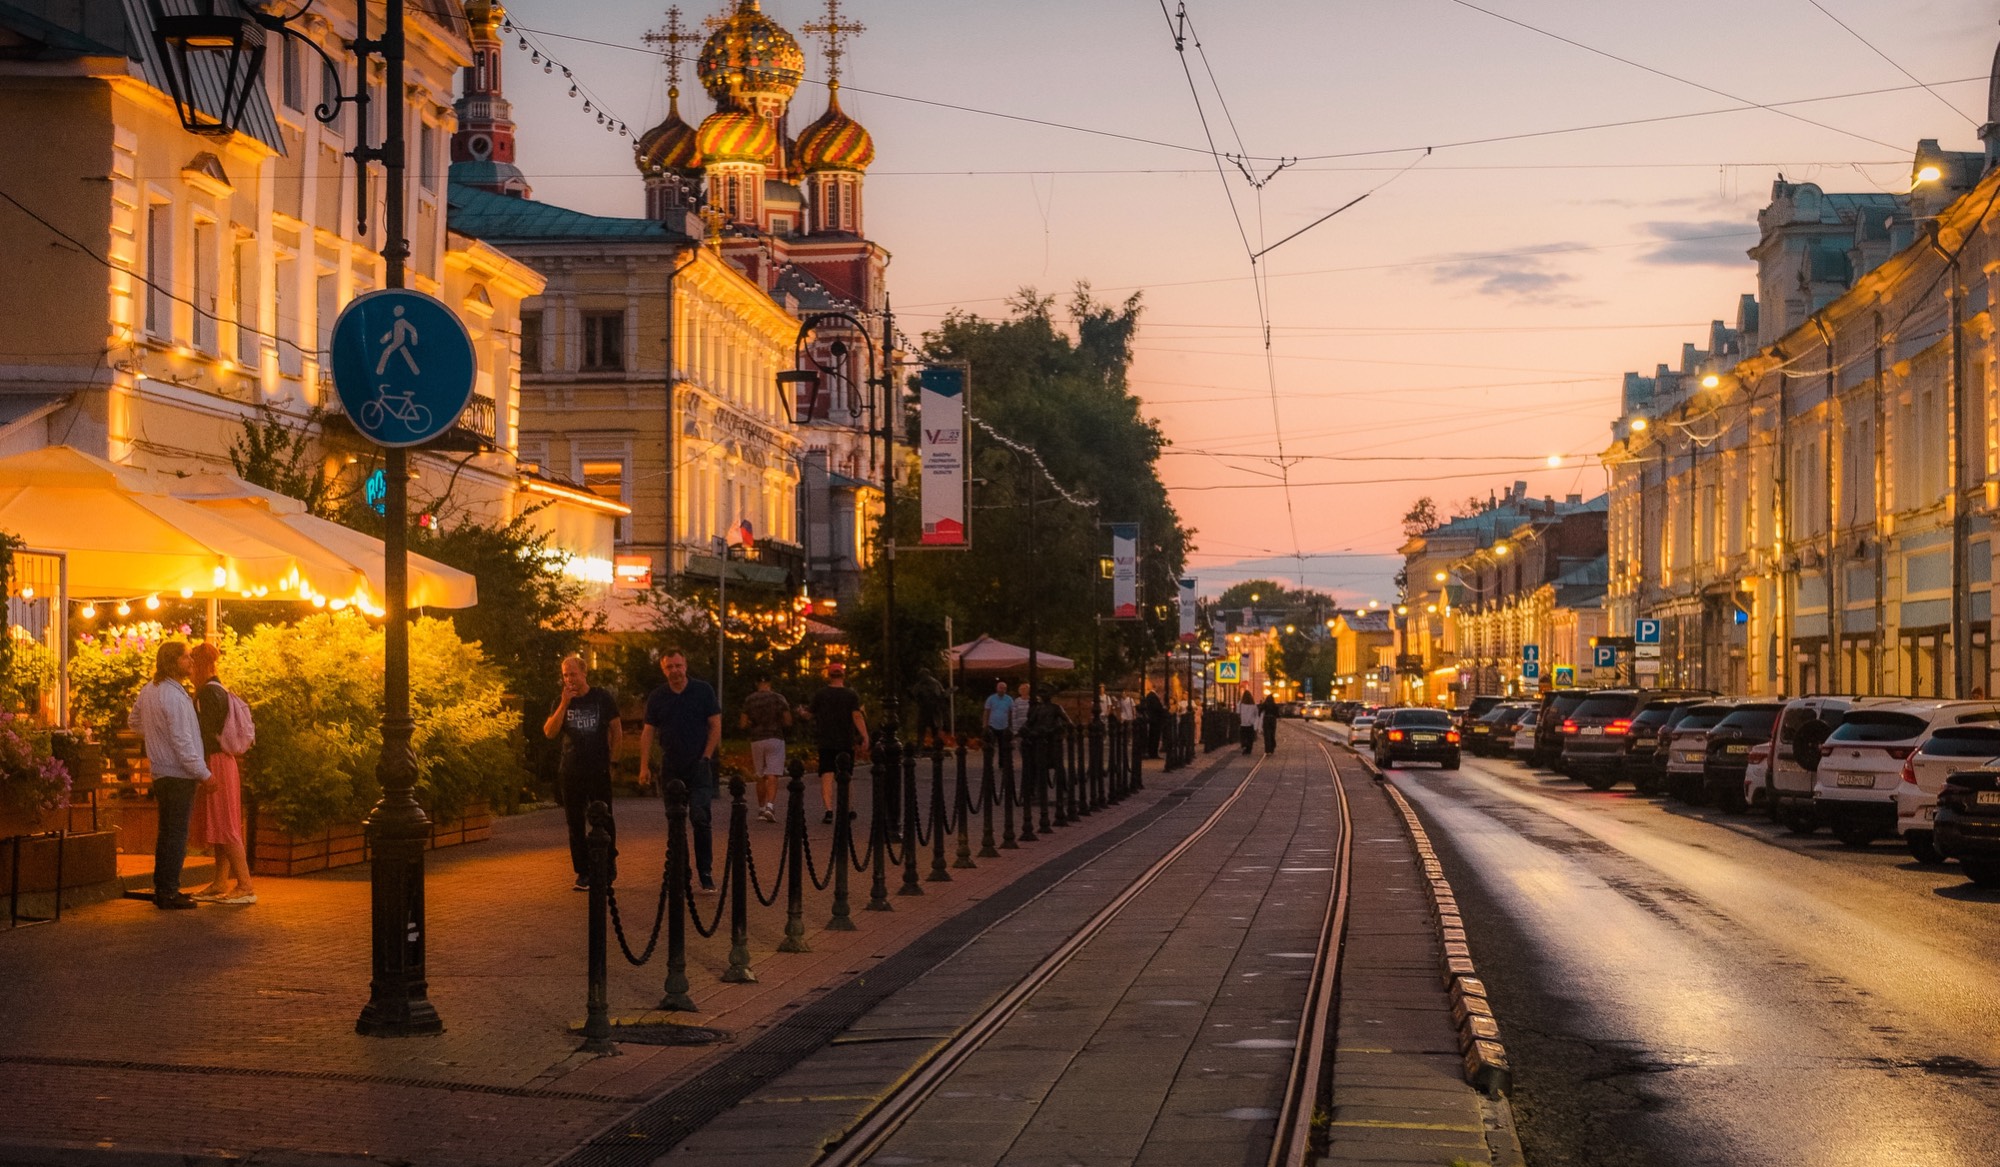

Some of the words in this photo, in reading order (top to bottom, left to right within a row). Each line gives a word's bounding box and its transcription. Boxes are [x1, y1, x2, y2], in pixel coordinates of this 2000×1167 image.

[1641, 621, 1656, 641] P
[1598, 649, 1611, 665] P
[1526, 664, 1535, 676] P
[577, 718, 596, 728] CUP
